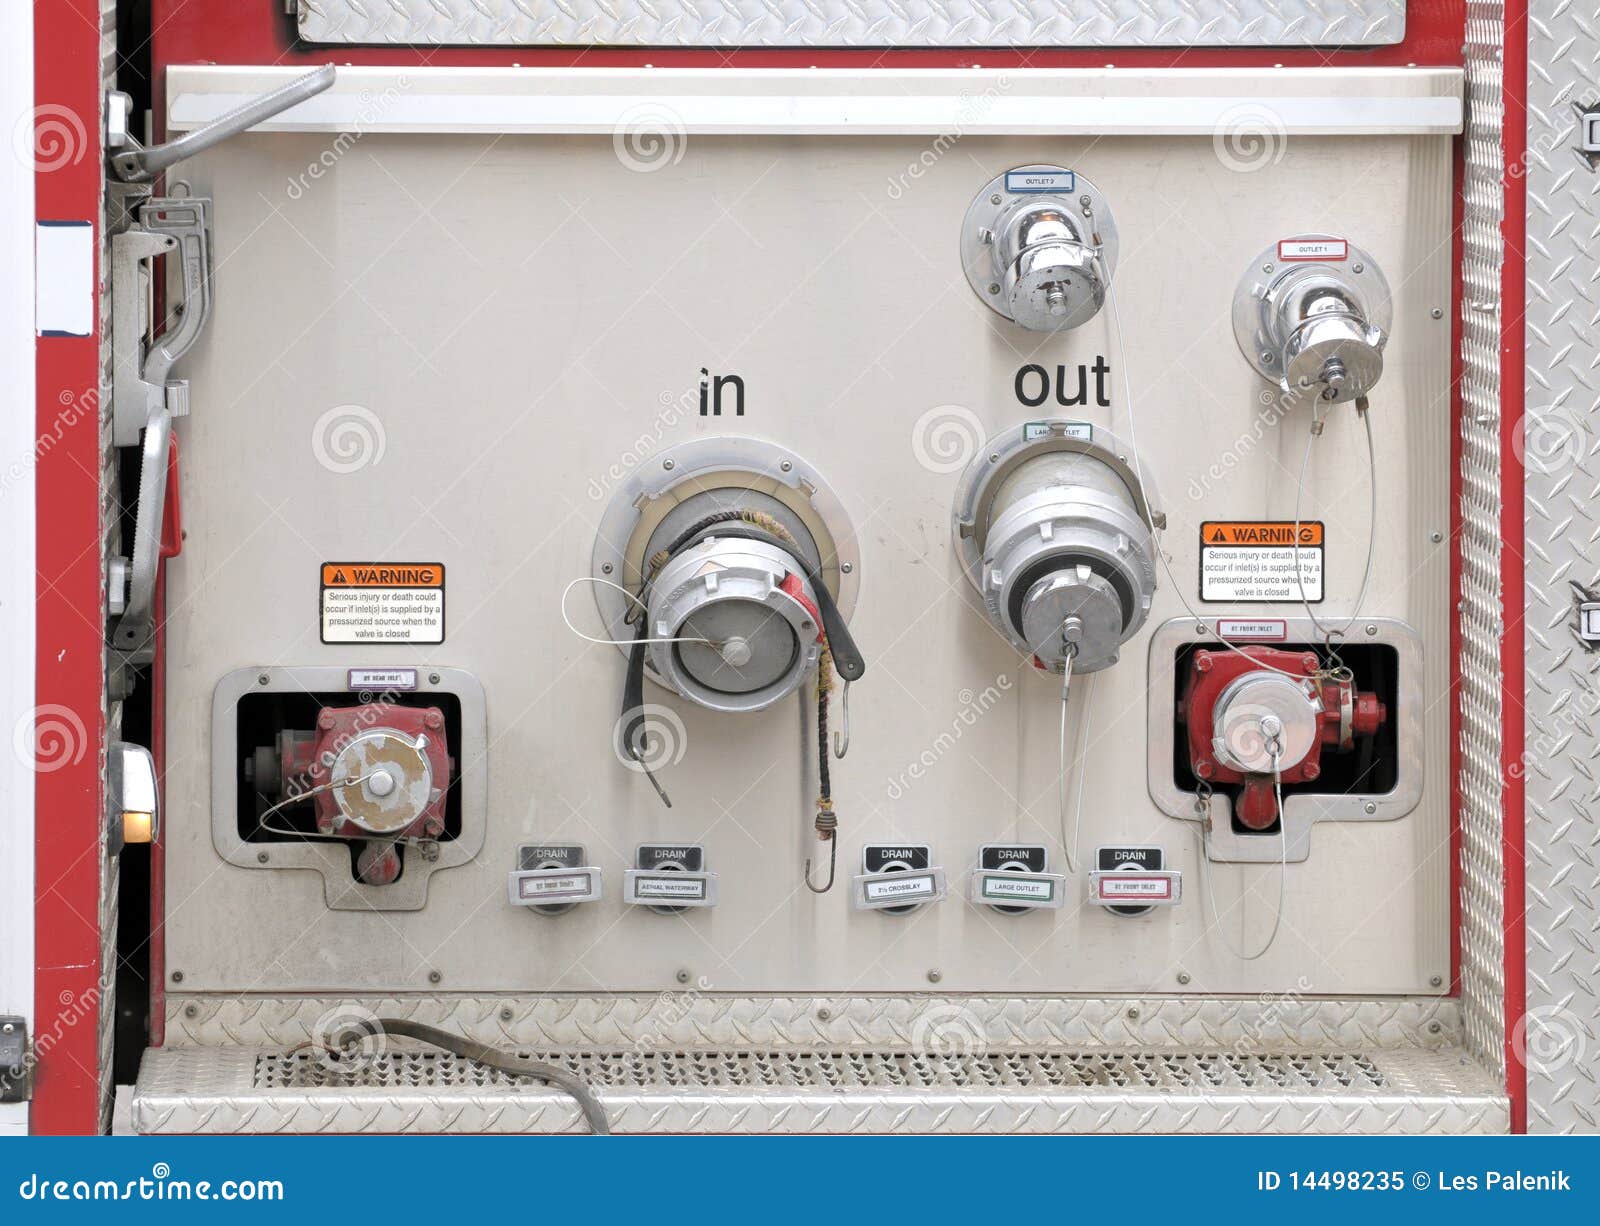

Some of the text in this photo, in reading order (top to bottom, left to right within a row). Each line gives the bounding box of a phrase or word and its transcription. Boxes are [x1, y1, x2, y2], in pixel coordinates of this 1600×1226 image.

[1015, 355, 1110, 407] out
[699, 367, 745, 416] in
[1233, 528, 1314, 542] WARNING
[1209, 551, 1237, 559] Serious
[1240, 551, 1260, 561] injury
[1272, 551, 1292, 559] death
[1295, 551, 1316, 559] ould
[1235, 564, 1259, 573] inlet(s)
[1304, 564, 1313, 573] by
[353, 569, 434, 583] WARNING
[1209, 576, 1252, 585] pressurized
[1304, 576, 1316, 584] the
[1234, 588, 1290, 596] valve is closed
[329, 592, 358, 601] Serious
[360, 592, 380, 602] injury
[392, 592, 413, 601] death
[415, 592, 436, 601] could
[348, 605, 354, 613] if
[355, 605, 380, 615] inlet(s)
[381, 605, 388, 613] is
[390, 605, 422, 614] supplied
[424, 605, 433, 615] by
[329, 618, 372, 626] pressurized
[536, 849, 568, 858] DRAIN
[655, 849, 686, 859] DRAIN
[881, 849, 913, 859] DRAIN
[998, 850, 1030, 859] DRAIN
[1114, 851, 1146, 860] DRAIN
[888, 883, 921, 892] CROSSLAY
[994, 883, 1015, 891] LARGE
